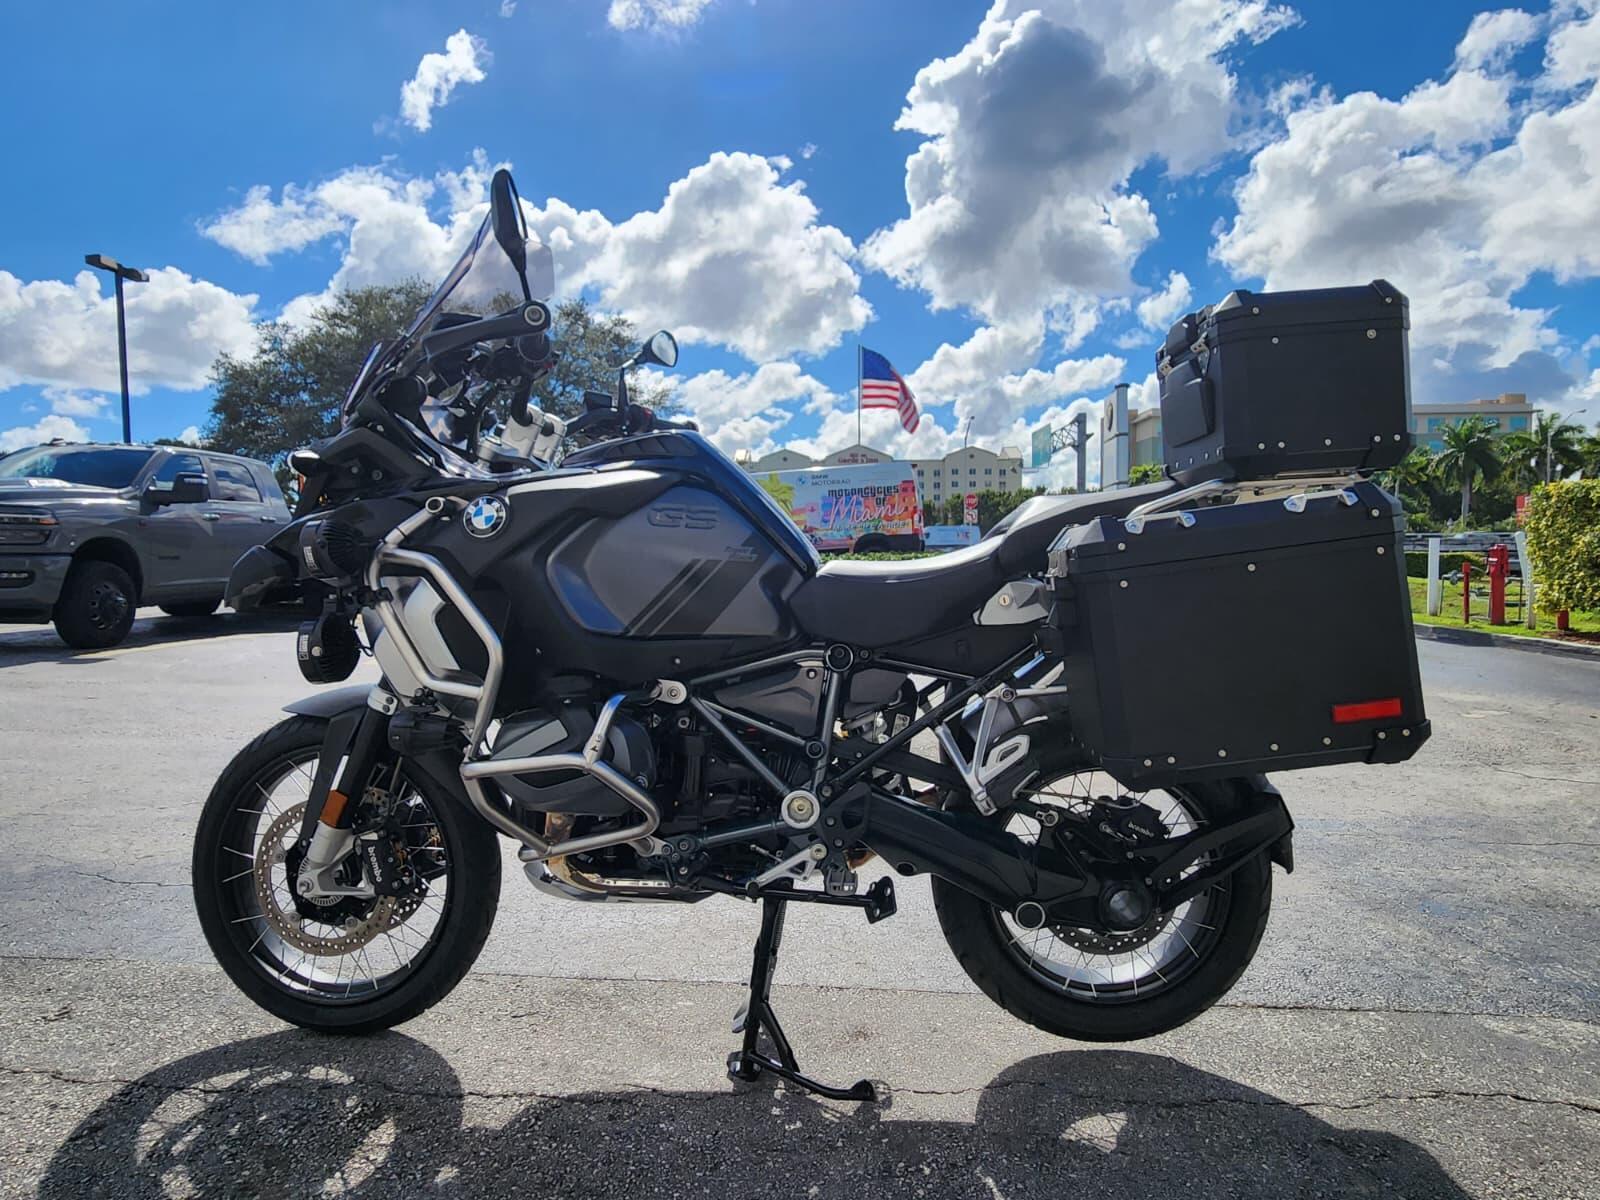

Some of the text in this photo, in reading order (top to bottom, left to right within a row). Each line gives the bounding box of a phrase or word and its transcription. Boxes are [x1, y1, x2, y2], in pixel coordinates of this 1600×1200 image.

[466, 497, 505, 518] BMW
[647, 504, 721, 531] GS
[367, 844, 383, 883] brembo
